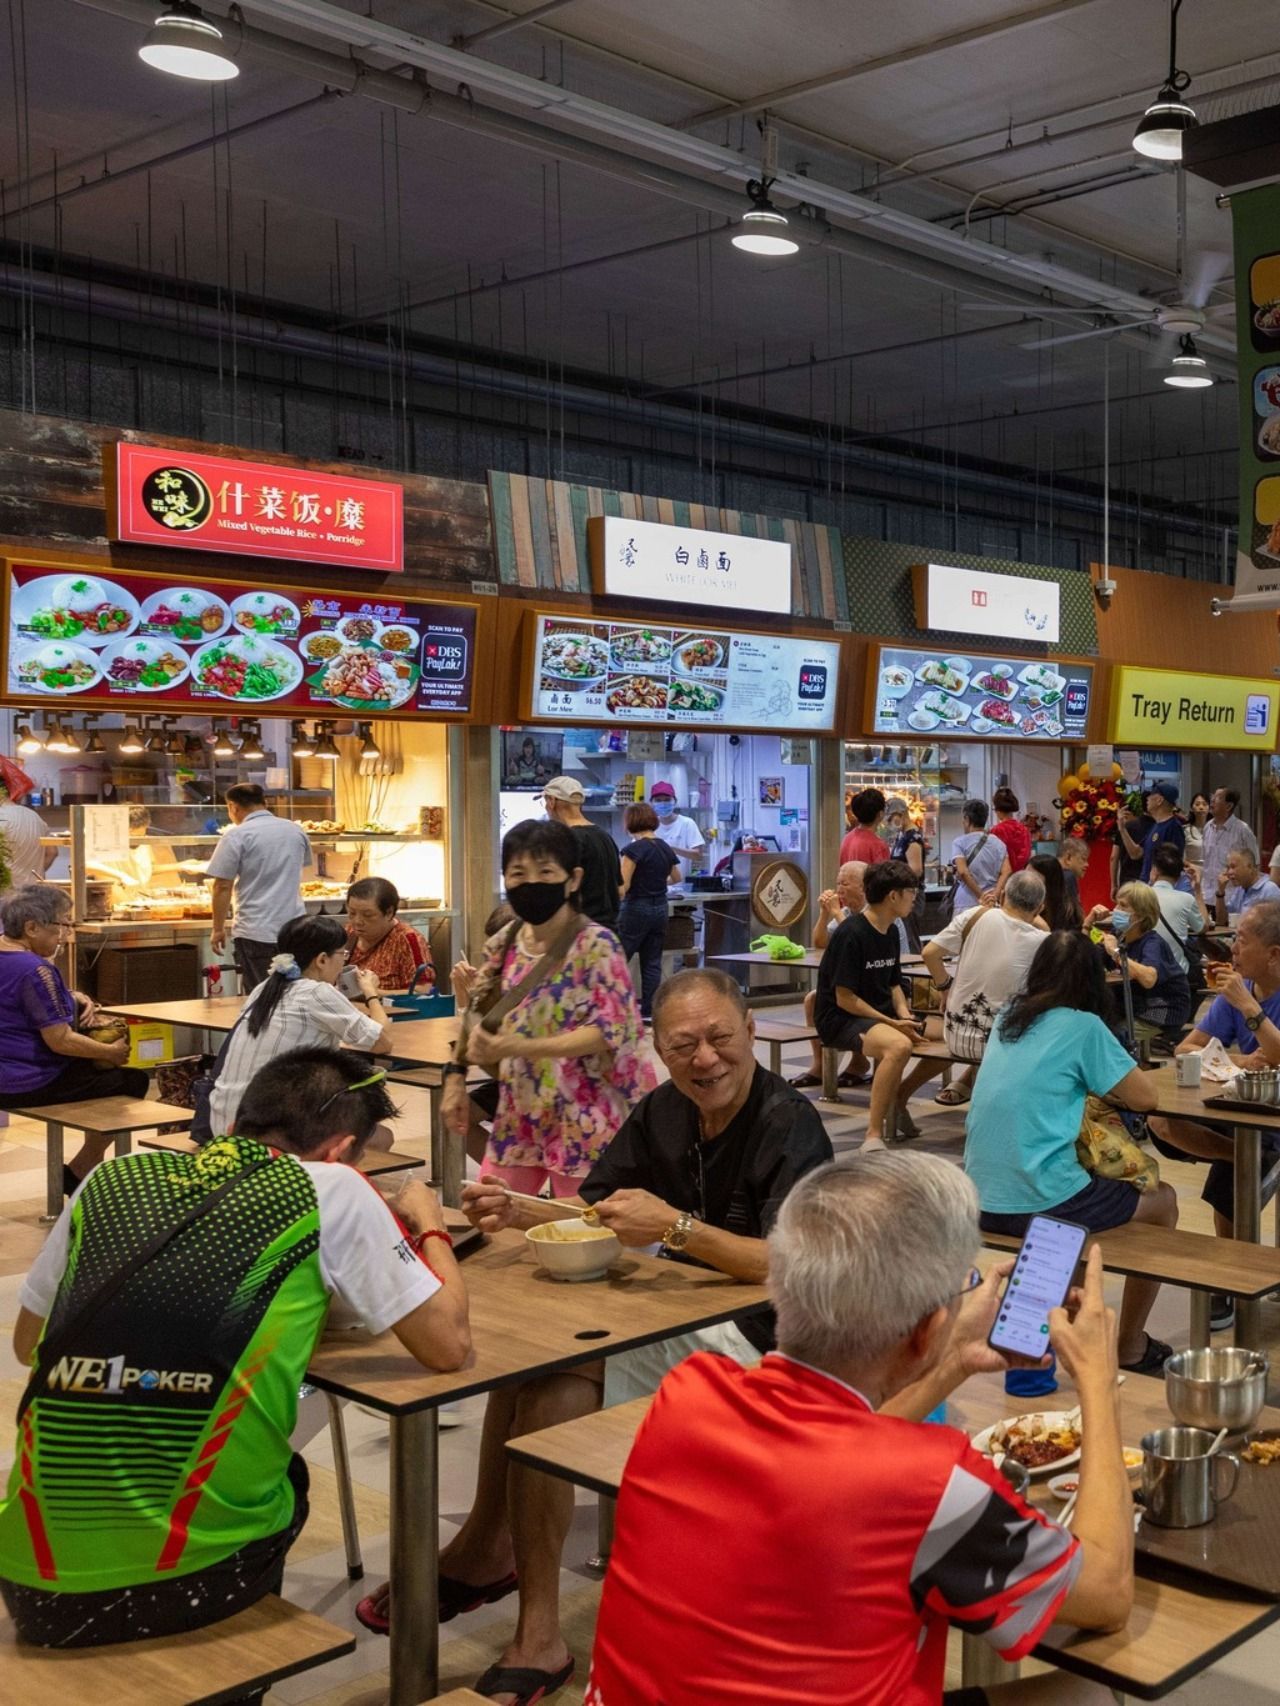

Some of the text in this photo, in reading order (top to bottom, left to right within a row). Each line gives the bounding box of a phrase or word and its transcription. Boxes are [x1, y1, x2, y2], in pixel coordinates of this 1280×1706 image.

[217, 519, 365, 547] Mixed Vegetable Rice Porridge
[438, 646, 461, 657] DBS
[426, 657, 461, 672] PayLah!
[809, 674, 825, 683] DBS
[1132, 694, 1235, 725] Tray Return
[122, 1367, 214, 1393] POKER
